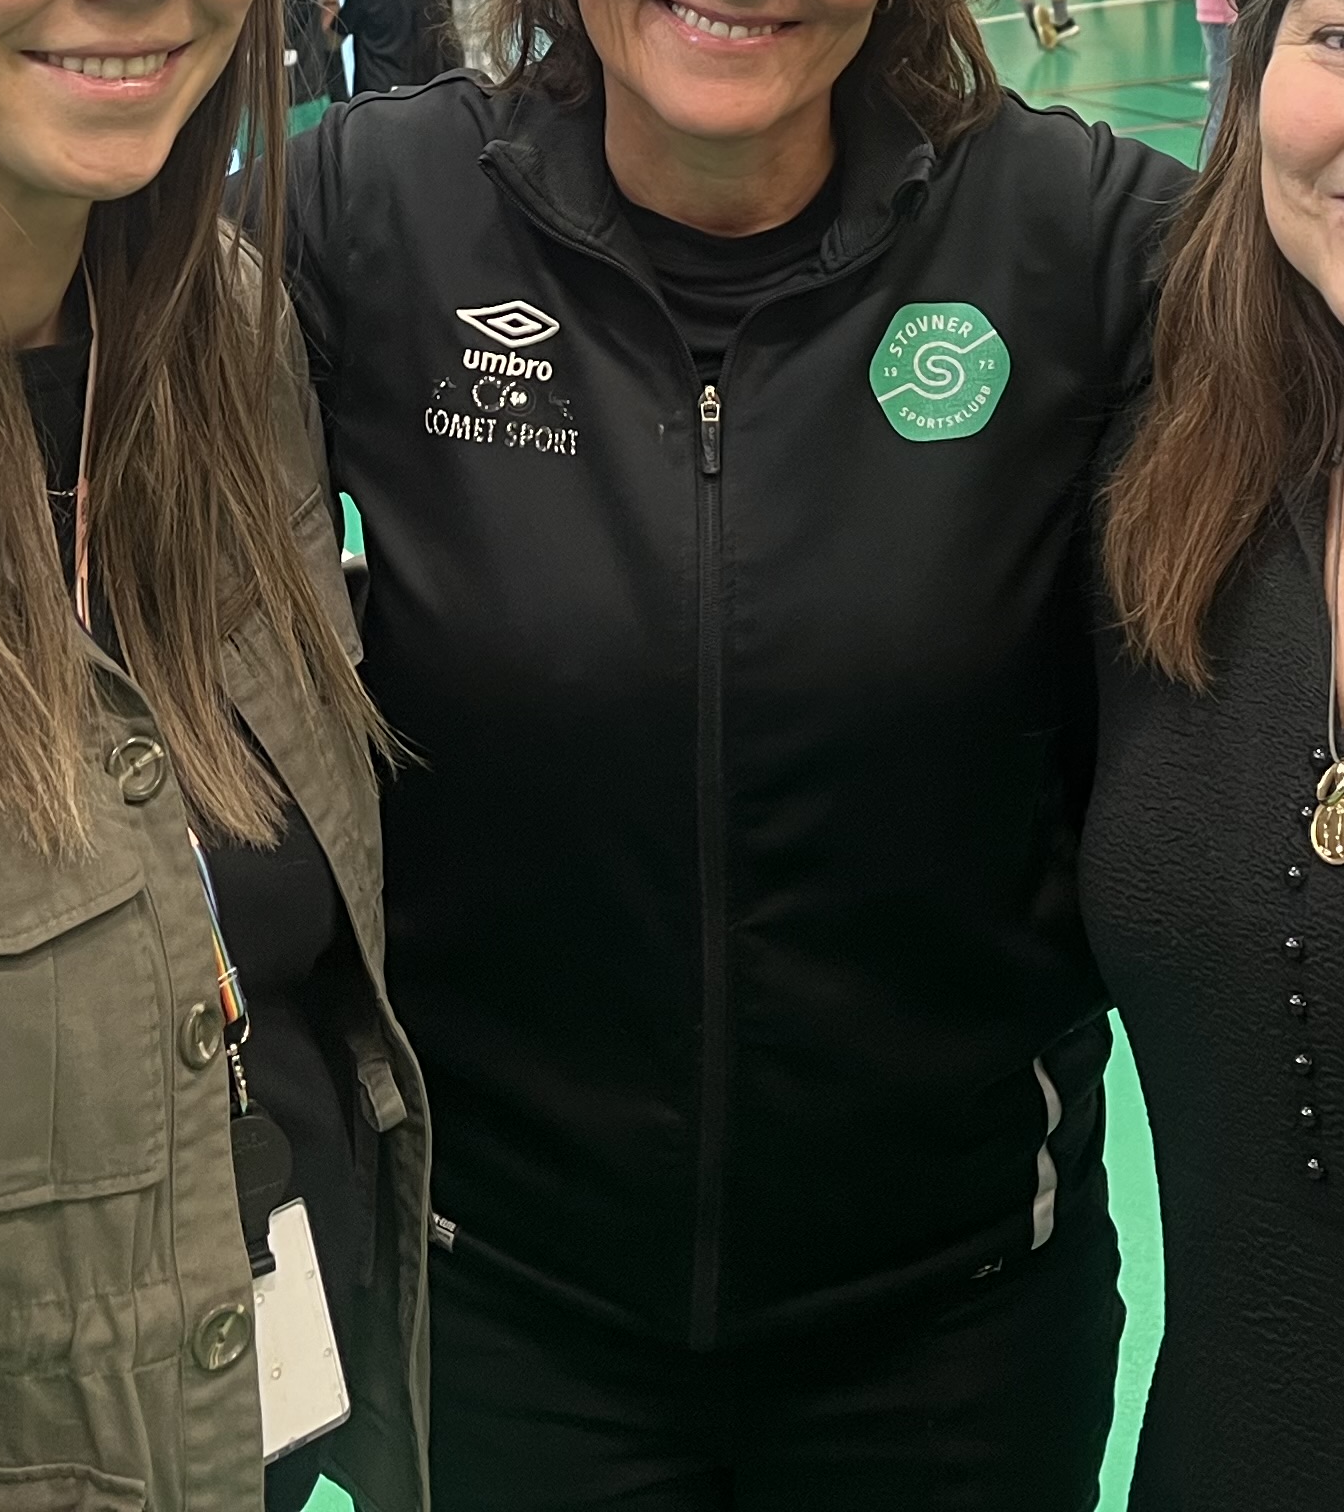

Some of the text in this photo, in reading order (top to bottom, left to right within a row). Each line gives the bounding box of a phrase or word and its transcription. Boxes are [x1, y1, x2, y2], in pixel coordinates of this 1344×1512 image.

[888, 314, 974, 358] STOVNER
[462, 348, 553, 382] umbro
[883, 359, 995, 378] 19 72
[898, 385, 992, 429] SPORTSKLUBB
[424, 406, 579, 456] COMET SPORT
